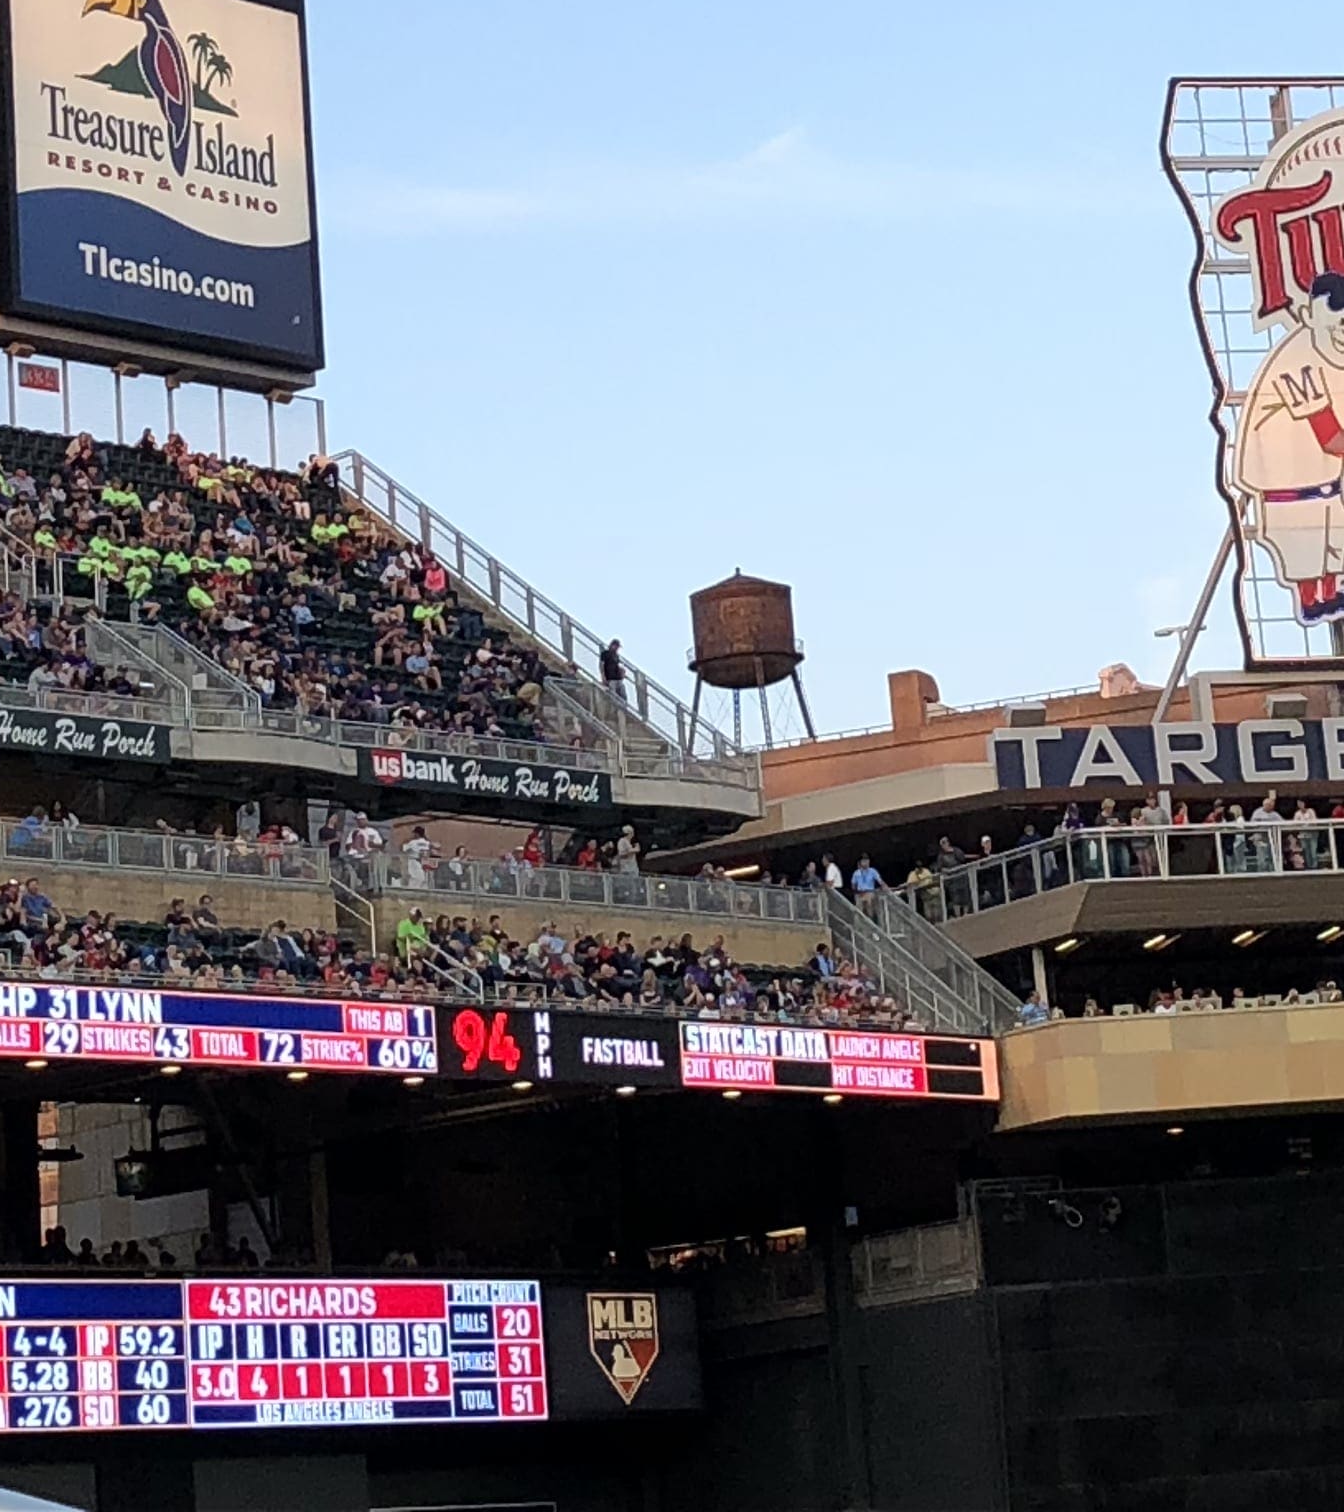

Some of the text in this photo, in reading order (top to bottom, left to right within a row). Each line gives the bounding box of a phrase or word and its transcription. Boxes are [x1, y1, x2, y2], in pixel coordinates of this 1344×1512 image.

[40, 81, 278, 188] Treasure Island
[46, 152, 279, 215] RESORT CASINO
[1279, 365, 1318, 409] M
[55, 719, 96, 751] Run
[101, 722, 155, 758] Porch
[461, 760, 509, 794] Home
[515, 767, 549, 797] Run
[553, 770, 599, 803] Porch
[49, 988, 79, 1019] 31
[88, 990, 163, 1024] LYNN
[349, 1008, 404, 1031] THIS AB
[45, 1022, 80, 1053] 29
[83, 1028, 152, 1053] STRIKES
[155, 1027, 190, 1058] 43
[198, 1031, 248, 1056] TOTAL
[263, 1032, 295, 1063] 72
[302, 1038, 364, 1061] STRIKE%
[378, 1038, 437, 1068] 60%
[453, 1009, 664, 1078] 94 MPH FASTBALL
[686, 1024, 828, 1060] STATCAST DATA
[830, 1036, 921, 1061] LAUNCH ANGLE
[685, 1058, 771, 1081] EXIT VELOCITY
[833, 1064, 916, 1089] HIT DISTANCE
[209, 1287, 377, 1317] 43 RICHARDS
[453, 1283, 530, 1302] PITCH COUNT
[453, 1309, 531, 1336] BALLS 20
[592, 1299, 654, 1329] MLB
[86, 1327, 108, 1356] IP
[119, 1326, 176, 1356] 59.2
[328, 1325, 358, 1357] ER
[451, 1346, 532, 1374] STRIKES 31
[11, 1361, 69, 1390] 5.28
[196, 1367, 235, 1397] 3.0
[17, 1396, 72, 1426] .276
[256, 1400, 394, 1422] LOS ANGELES ANGELS
[460, 1384, 534, 1413] TOTAL 51
